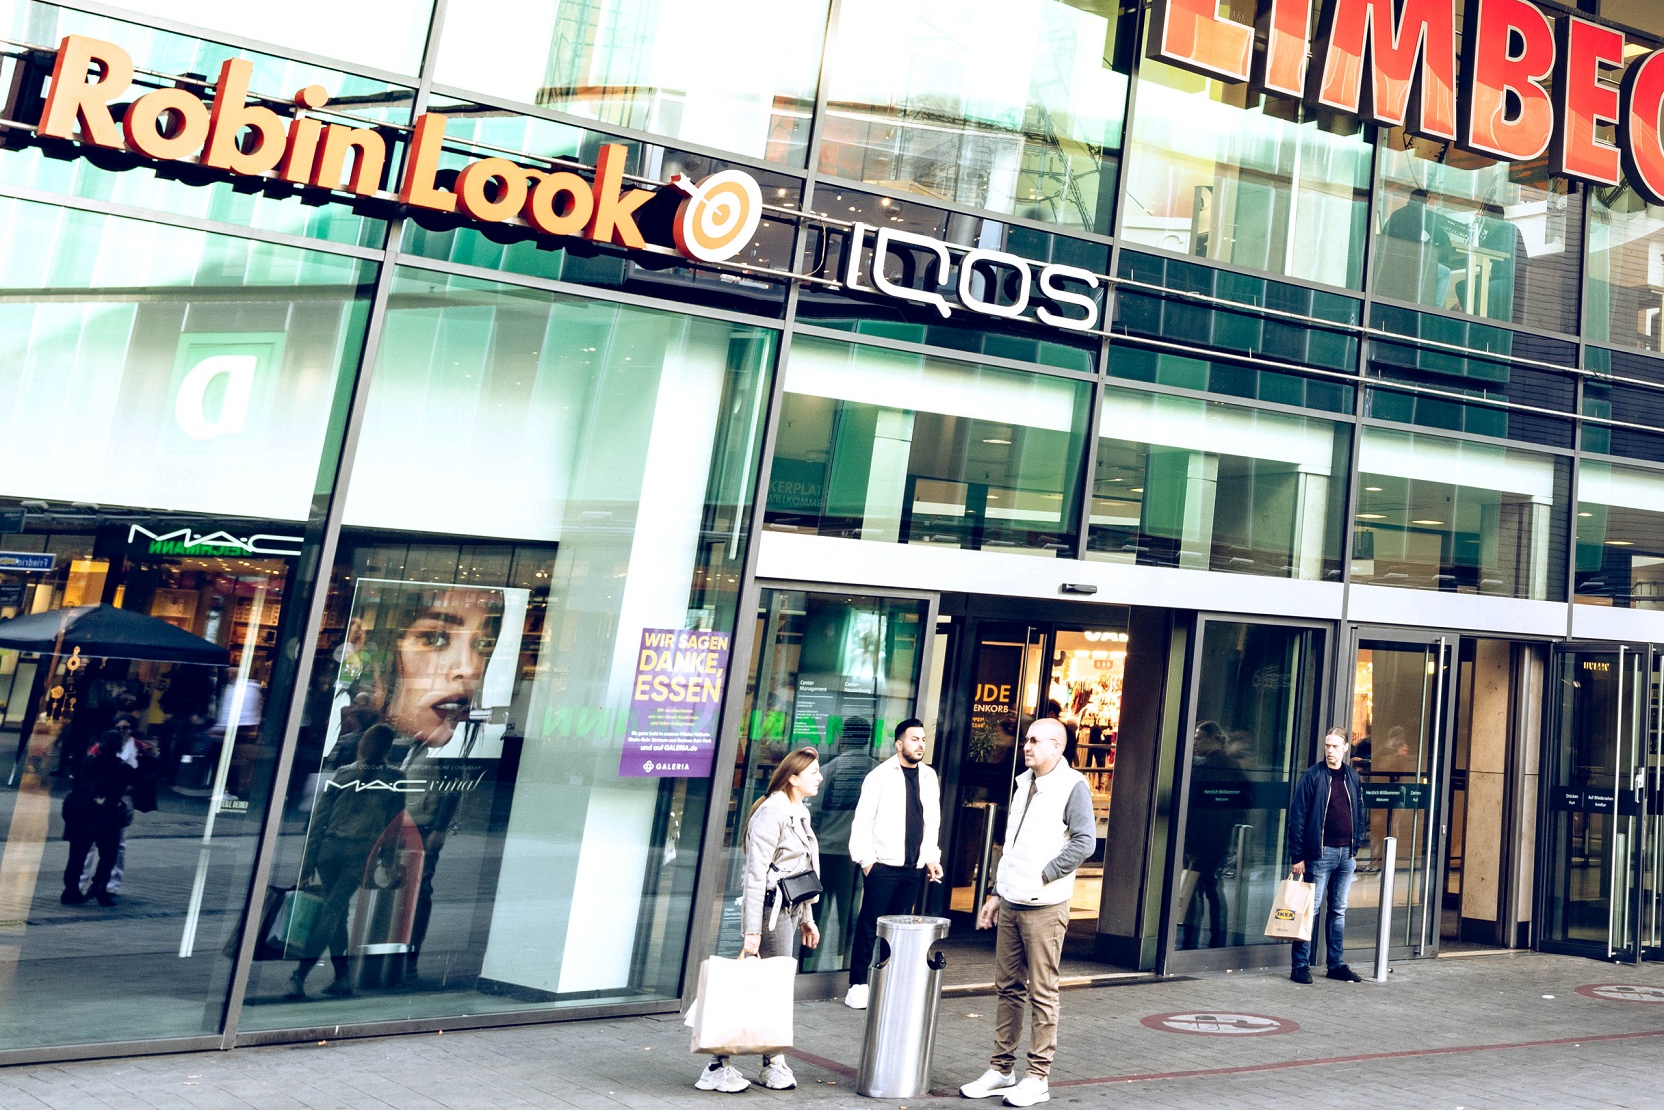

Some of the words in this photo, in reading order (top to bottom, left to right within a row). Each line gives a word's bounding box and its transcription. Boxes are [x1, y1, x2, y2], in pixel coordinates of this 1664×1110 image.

[38, 34, 387, 198] Robin
[400, 113, 657, 249] Look
[846, 222, 1099, 331] IQOS
[645, 632, 674, 647] WIR
[678, 634, 728, 650] SAGEN
[639, 649, 723, 678] DANKE,
[635, 675, 722, 703] ESSEN
